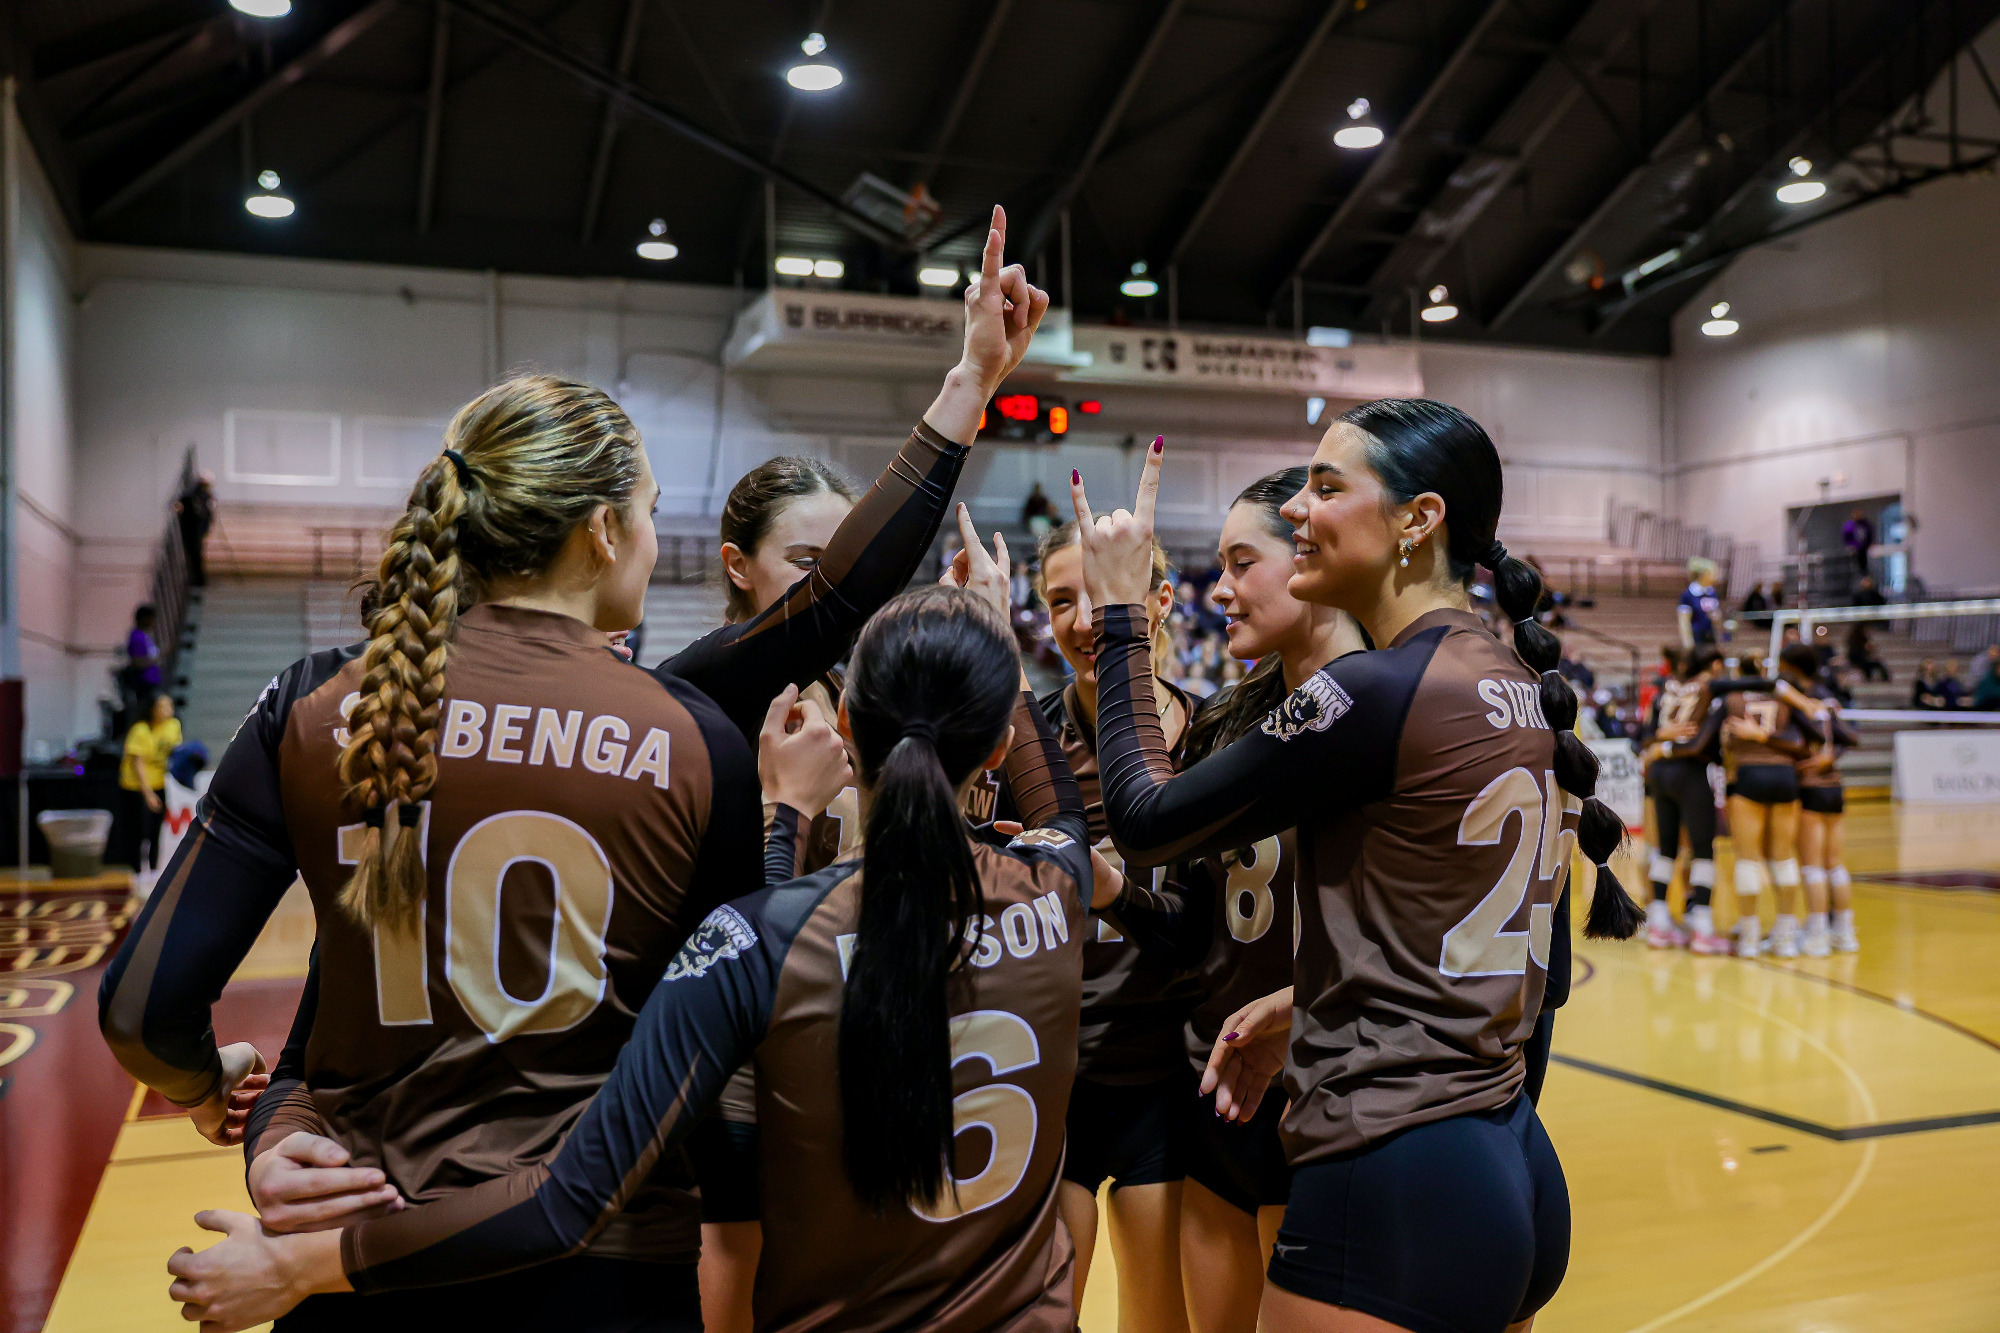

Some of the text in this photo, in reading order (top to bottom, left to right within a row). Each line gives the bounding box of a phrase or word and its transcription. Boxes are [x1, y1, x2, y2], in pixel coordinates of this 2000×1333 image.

[332, 688, 670, 789] BENGA
[337, 800, 615, 1043] 10
[1438, 766, 1583, 978] 25
